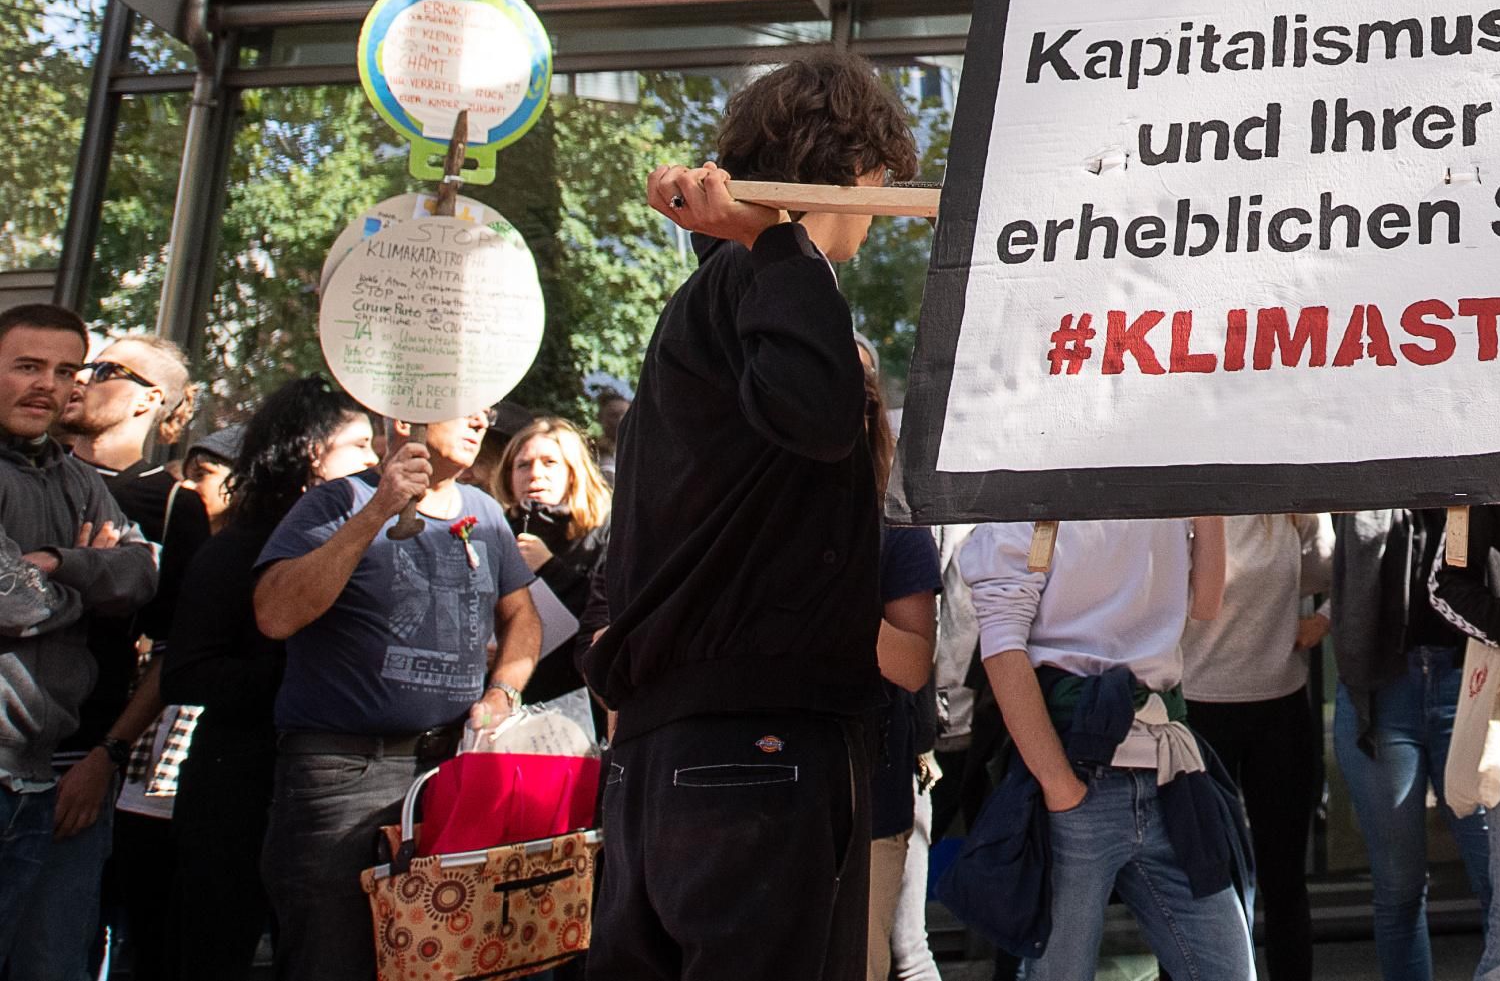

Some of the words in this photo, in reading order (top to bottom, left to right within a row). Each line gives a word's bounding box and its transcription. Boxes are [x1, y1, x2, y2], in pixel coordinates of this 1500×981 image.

[1138, 103, 1282, 166] und
[1311, 98, 1493, 154] Ihrer
[997, 193, 1461, 264] erheblichen
